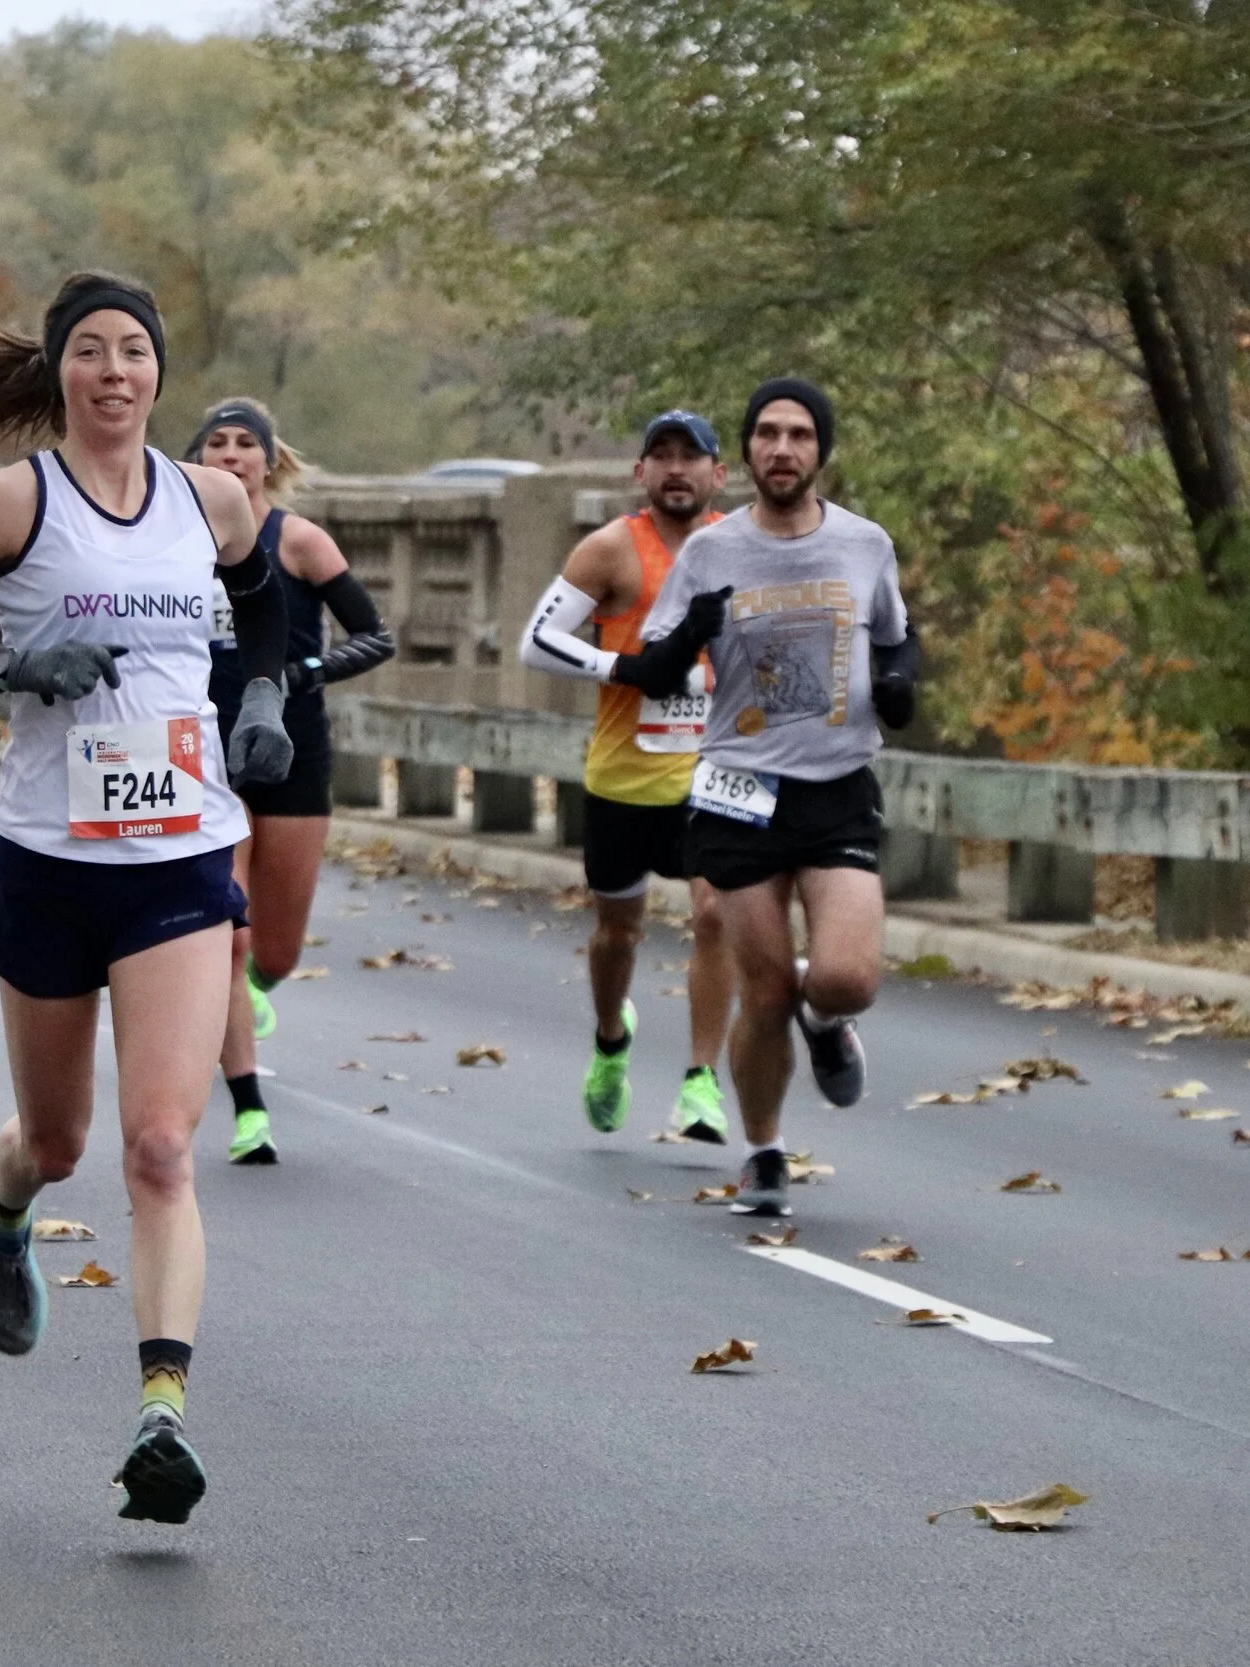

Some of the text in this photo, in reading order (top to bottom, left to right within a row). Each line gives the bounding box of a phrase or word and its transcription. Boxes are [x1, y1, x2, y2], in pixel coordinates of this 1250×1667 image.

[64, 593, 203, 619] DWRUNNING
[661, 694, 705, 718] 9333
[181, 732, 194, 743] 20
[181, 744, 195, 755] 19
[103, 770, 176, 811] F244
[118, 823, 163, 837] Lauren
